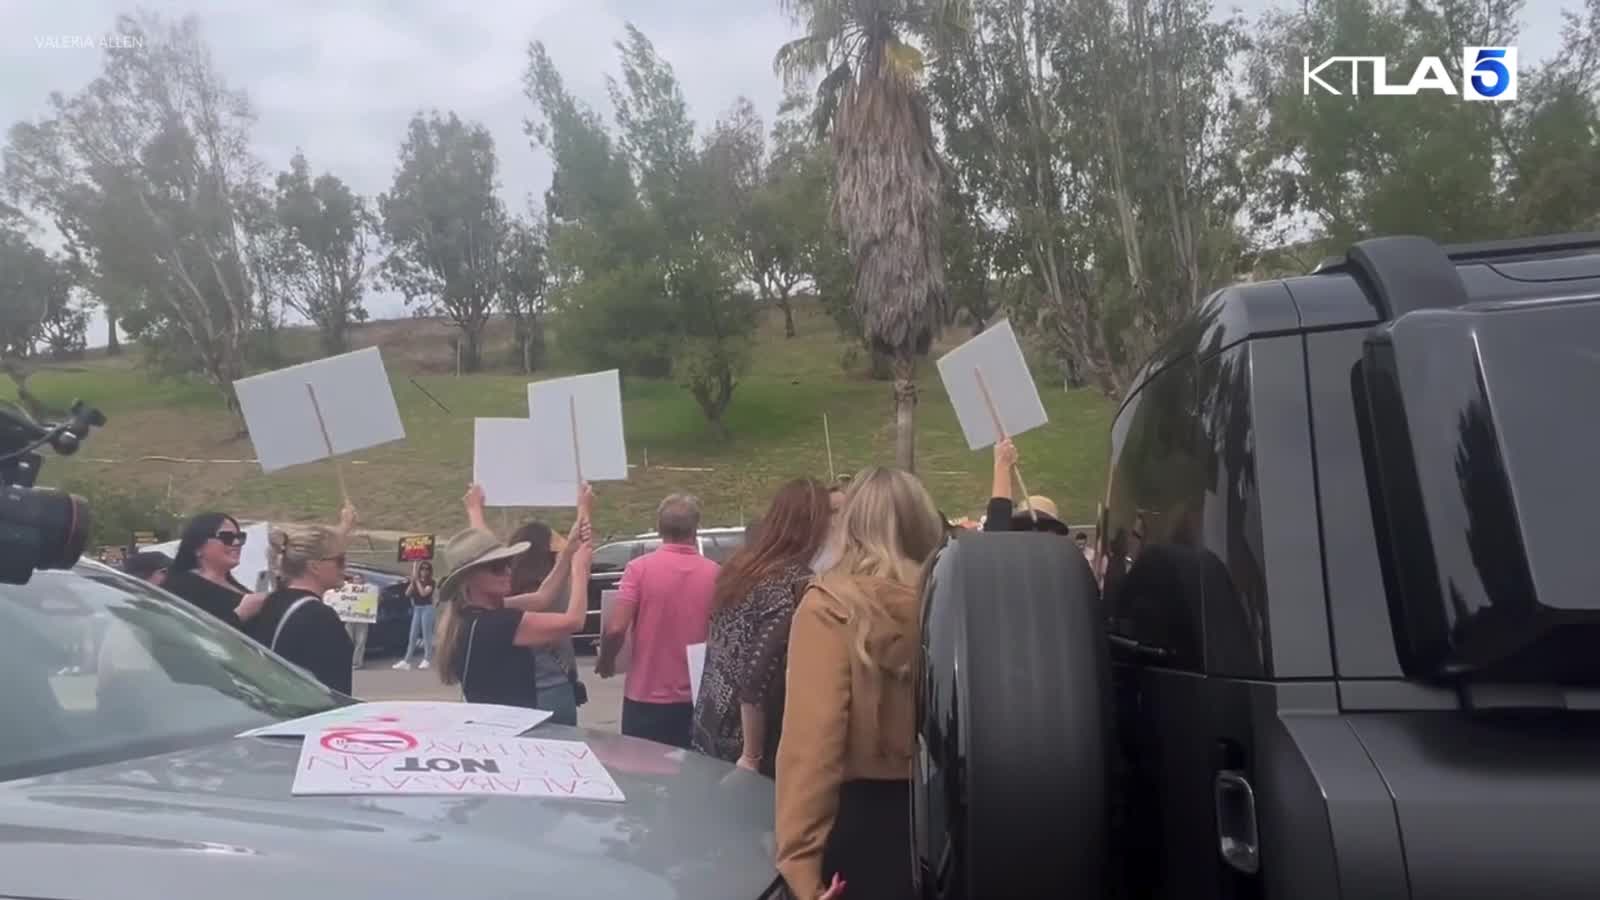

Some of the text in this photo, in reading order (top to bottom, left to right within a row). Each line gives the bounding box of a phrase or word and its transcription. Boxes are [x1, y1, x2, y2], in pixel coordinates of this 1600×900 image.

[307, 755, 387, 771] AN
[394, 757, 500, 773] NOT
[349, 775, 614, 795] CALABASAS
